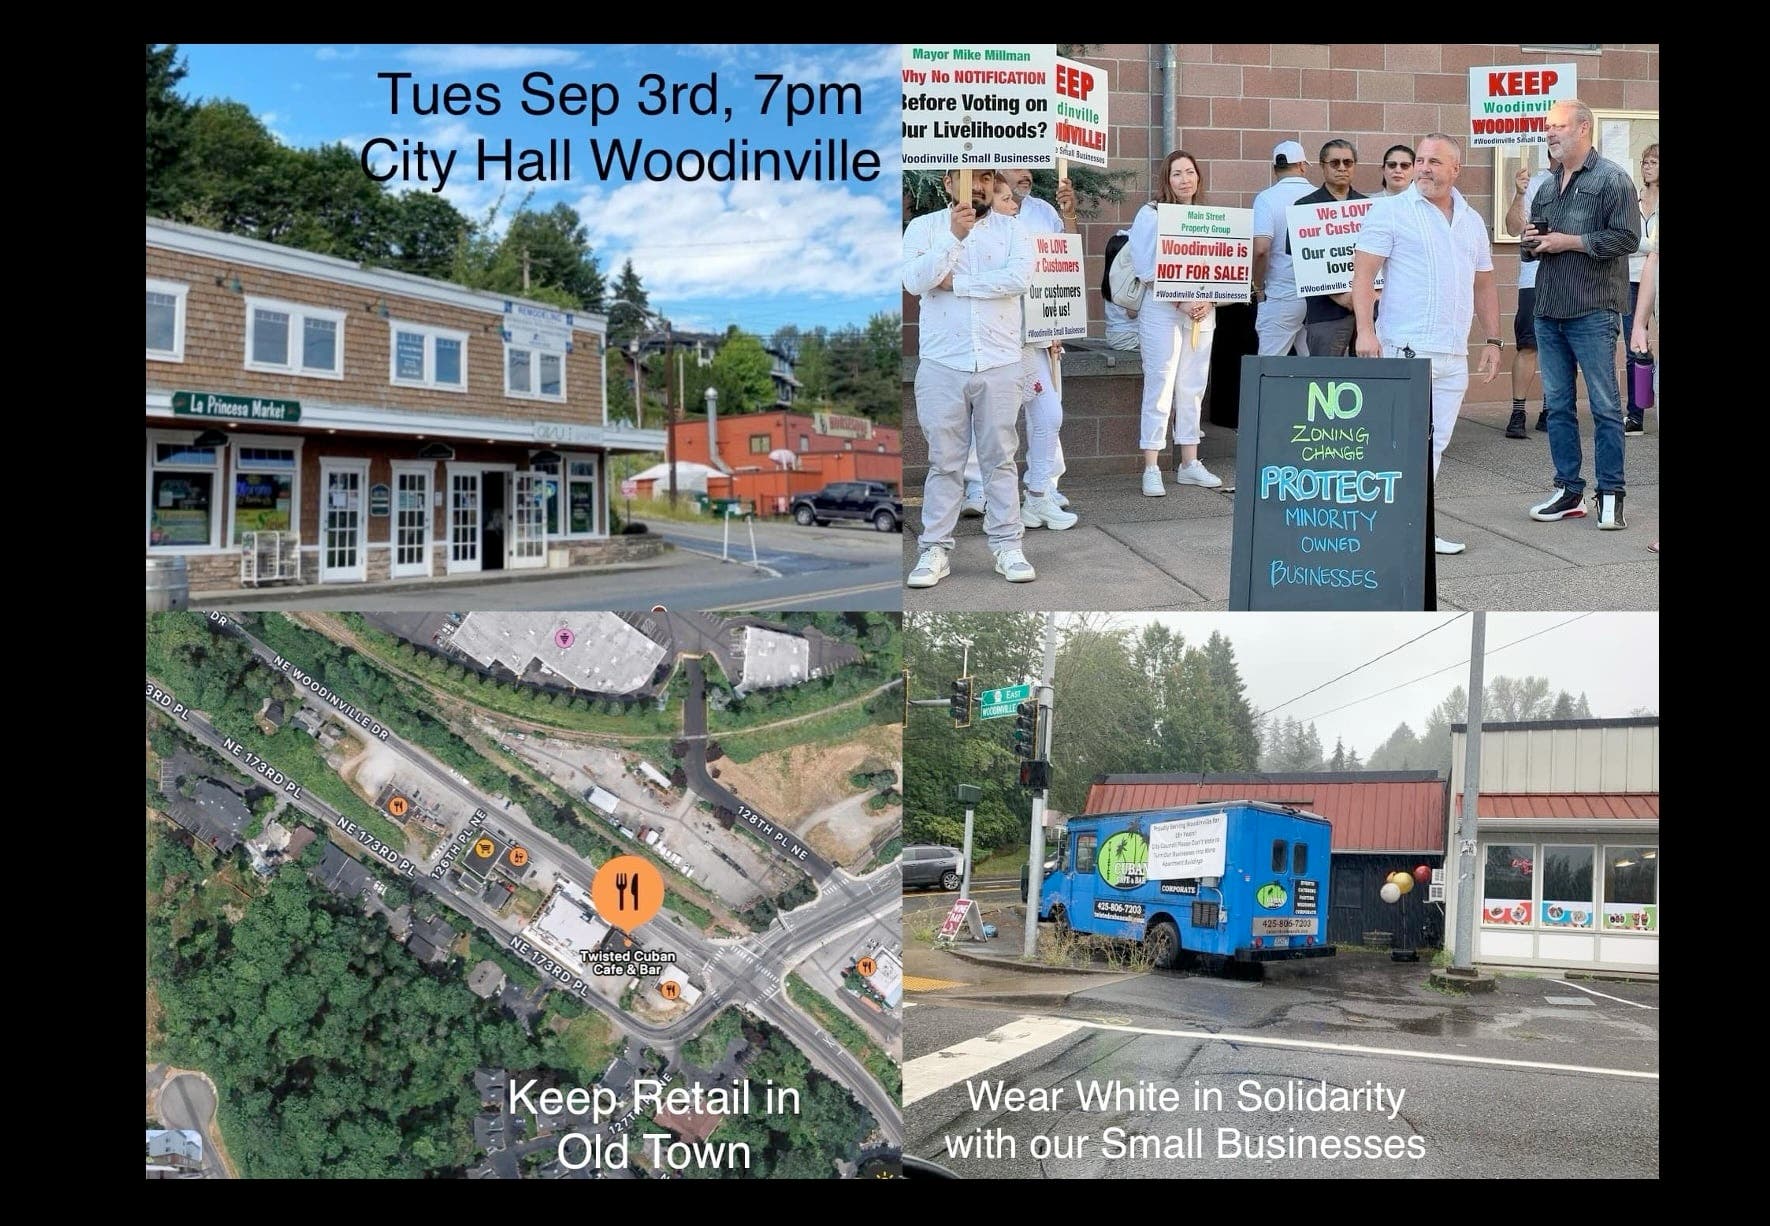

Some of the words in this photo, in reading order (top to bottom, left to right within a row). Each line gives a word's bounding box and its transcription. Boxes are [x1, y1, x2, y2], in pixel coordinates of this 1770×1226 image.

[912, 48, 949, 62] Mayor
[953, 49, 980, 60] Mike
[985, 49, 1030, 61] Millman
[932, 70, 950, 83] No
[954, 70, 1045, 85] NOTIFICATION
[1056, 64, 1094, 101] EEP
[1489, 71, 1558, 96] KEEP
[962, 94, 1019, 115] Voting
[1026, 98, 1048, 111] on
[1484, 100, 1556, 113] Woodinvil
[1057, 102, 1099, 124] dinville
[934, 122, 1048, 138] Livelihoods?
[1472, 117, 1547, 134] WOODINVI
[1056, 122, 1106, 151] INVILLE!
[962, 153, 990, 164] Small
[994, 153, 1050, 164] Businesses
[1060, 147, 1074, 156] Small
[1076, 150, 1104, 163] Businesses
[1188, 211, 1204, 220] Main
[1206, 212, 1225, 221] Street
[1316, 208, 1337, 220] We
[1182, 223, 1210, 234] Property
[1212, 224, 1230, 235] Group
[1298, 227, 1321, 238] our
[1326, 221, 1361, 235] Custo
[1037, 239, 1049, 254] We
[1050, 239, 1068, 254] LOVE
[1162, 240, 1234, 257] Woodinville
[1237, 243, 1248, 257] is
[1302, 247, 1325, 260] Our
[1042, 258, 1079, 273] Customers
[1158, 264, 1182, 279] NOT
[1186, 265, 1210, 279] FOR
[1214, 266, 1248, 280] SALE!
[1327, 261, 1354, 273] love
[1030, 284, 1042, 299] Our
[1044, 284, 1080, 298] customers
[1156, 290, 1194, 298] #Woodinville
[1300, 282, 1347, 292] #Woodinville
[1043, 302, 1057, 318] love
[1059, 302, 1070, 316] us!
[1028, 328, 1053, 337] #Woodinville
[1054, 328, 1064, 336] Small
[190, 394, 203, 413] La
[208, 395, 248, 416] Princesa
[252, 399, 286, 419] Market
[1308, 381, 1363, 422] NO
[1290, 425, 1369, 446] ZONING
[1302, 445, 1364, 462] CHANGE
[1261, 466, 1402, 503] PROTECT
[1286, 508, 1378, 532] MINORITY
[1302, 536, 1361, 552] OWNED
[1270, 560, 1378, 589] BUSINESSES
[211, 611, 226, 626] DR
[273, 656, 291, 673] NE
[292, 666, 370, 729] WOODINVILLE
[370, 722, 389, 741] DR
[173, 704, 189, 720] PL
[223, 737, 243, 758] NE
[244, 750, 284, 786] 173RD
[285, 778, 302, 798] PL
[737, 805, 773, 837] 128TH
[773, 829, 788, 847] PL
[790, 840, 808, 862] NE
[336, 816, 356, 836] NE
[357, 829, 399, 864] 173RD
[399, 857, 415, 877] PL
[430, 841, 463, 880] 126TH
[459, 830, 473, 846] PL
[470, 808, 487, 829] NE
[1162, 885, 1196, 894] CORPORATE
[1098, 902, 1142, 914] 425-806-7203
[581, 949, 630, 964] Twisted
[634, 949, 676, 964] Cuban
[509, 937, 530, 953] NE
[530, 950, 571, 985] 173RD
[570, 979, 588, 997] PL
[593, 963, 624, 976] Cafe
[627, 964, 636, 976] &
[639, 964, 662, 976] Bar
